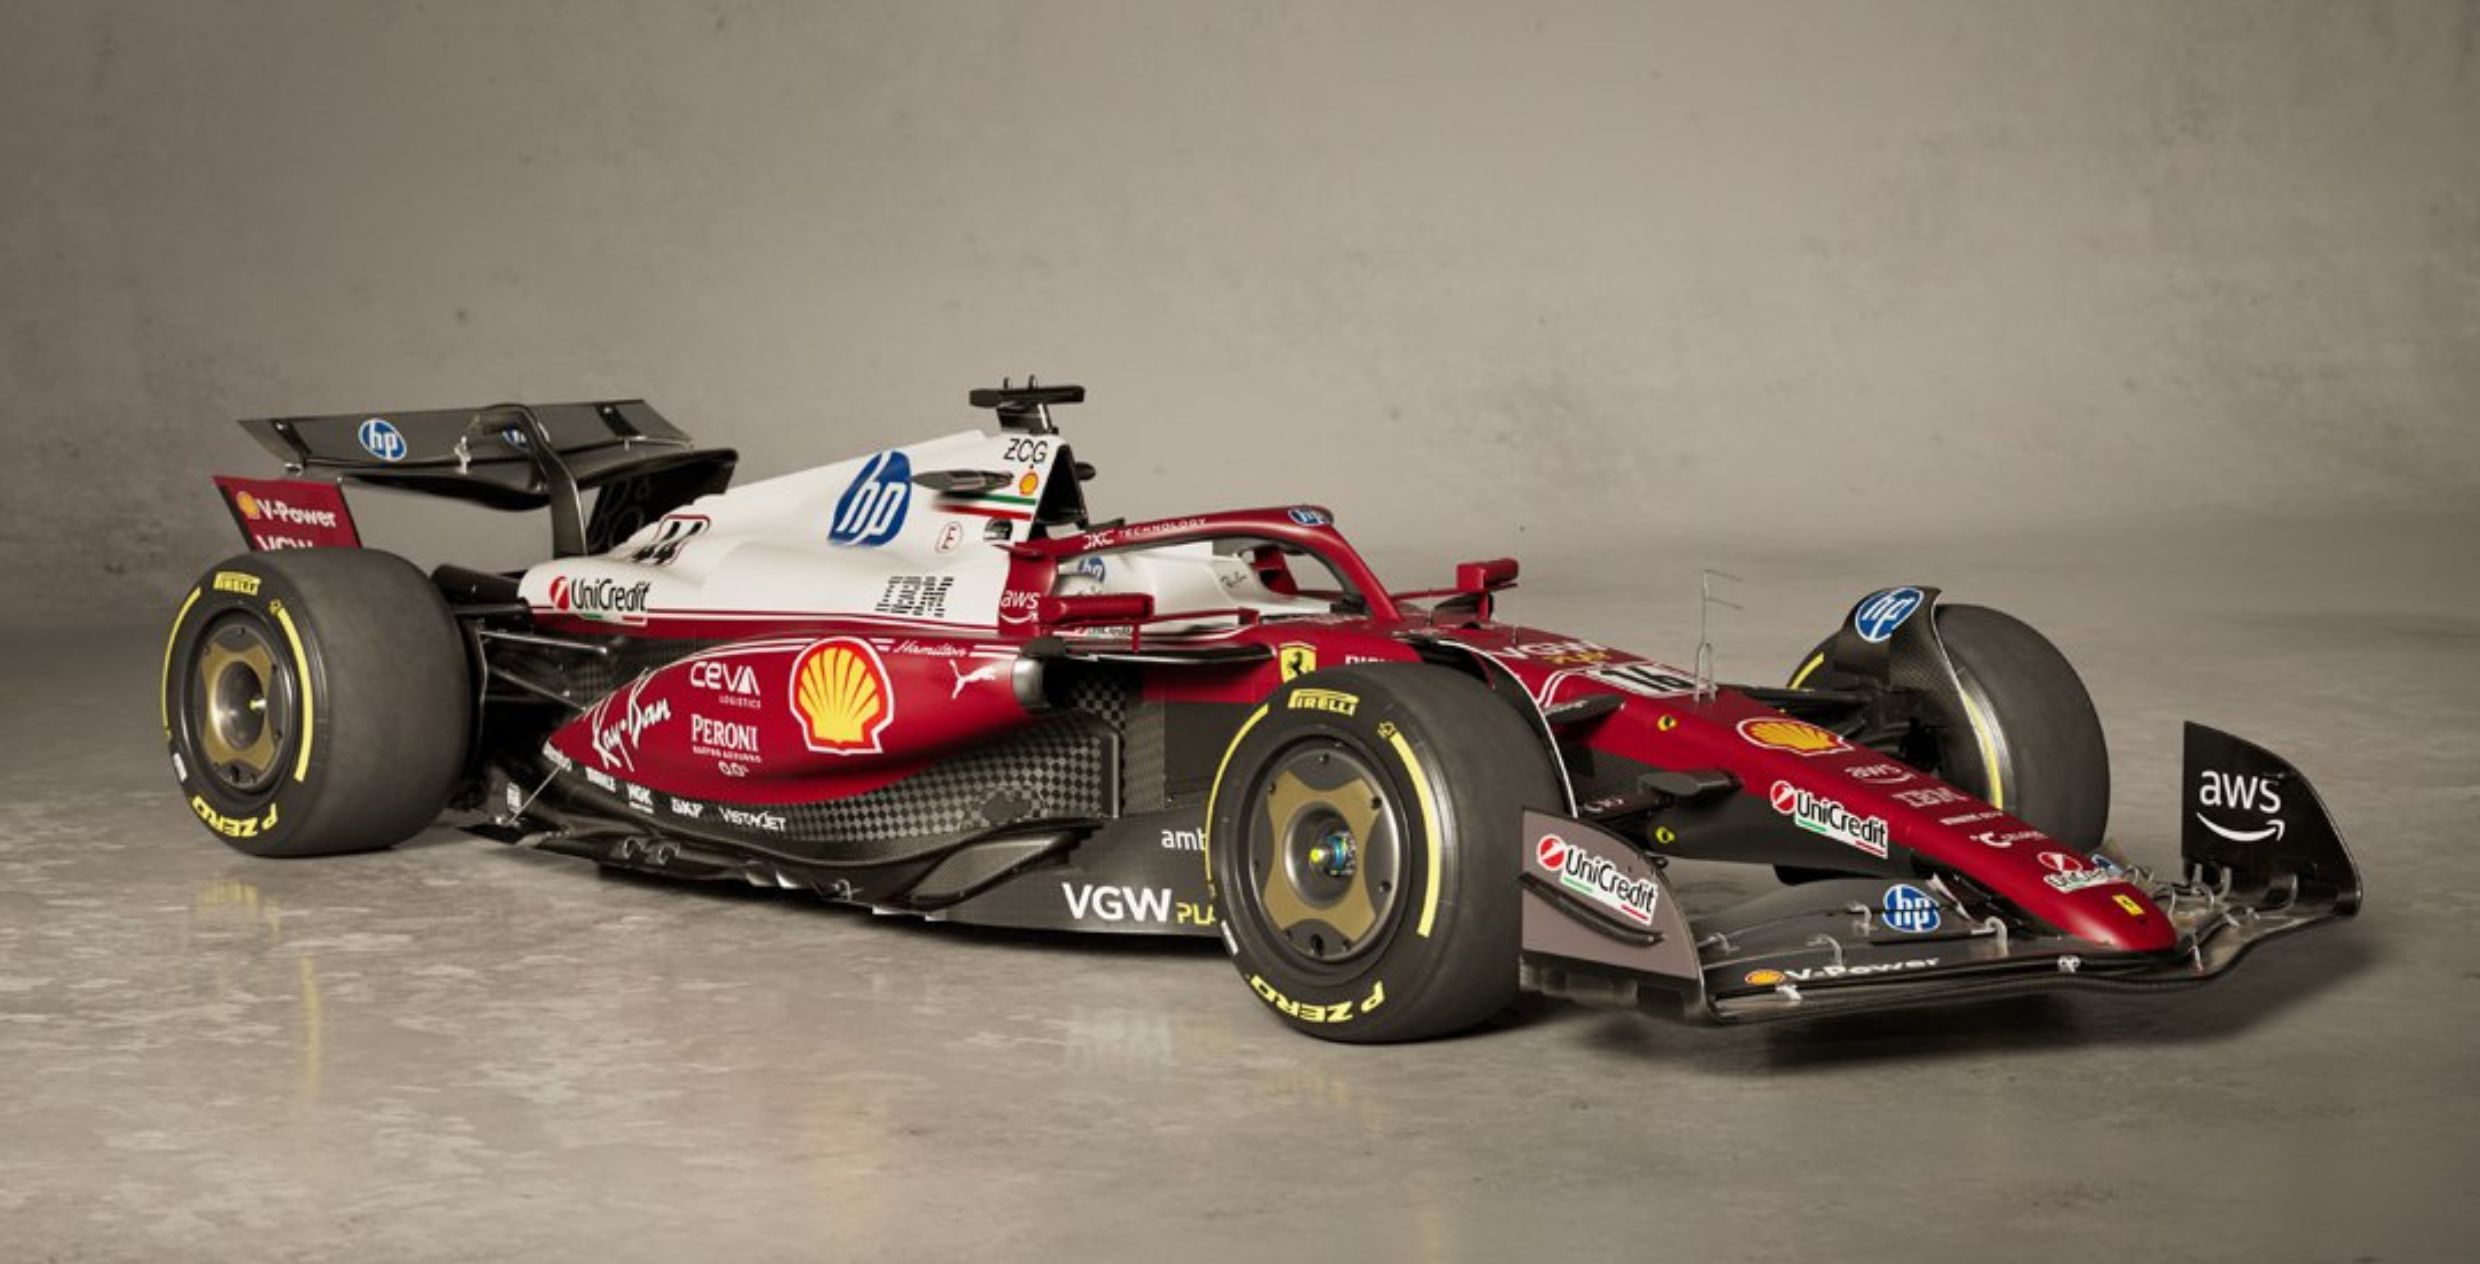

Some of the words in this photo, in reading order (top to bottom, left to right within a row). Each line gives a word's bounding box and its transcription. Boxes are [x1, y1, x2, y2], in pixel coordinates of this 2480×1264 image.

[1004, 438, 1048, 464] ZCG
[256, 498, 337, 528] V-Power
[836, 450, 906, 545] hp
[571, 579, 650, 612] UniCredit
[875, 576, 954, 618] IBM
[1000, 589, 1041, 609] aws
[893, 638, 967, 658] Hamilton
[1287, 688, 1361, 716] PIRELLI
[691, 714, 758, 752] PERONI
[2200, 769, 2282, 814] aws
[192, 795, 258, 837] ZERO
[261, 802, 278, 830] P
[1797, 791, 1886, 848] UniCredit
[1566, 848, 1656, 913] UniCredit
[1061, 881, 1172, 923] VGW
[1250, 974, 1354, 1022] ZERO
[1361, 980, 1384, 1012] P
